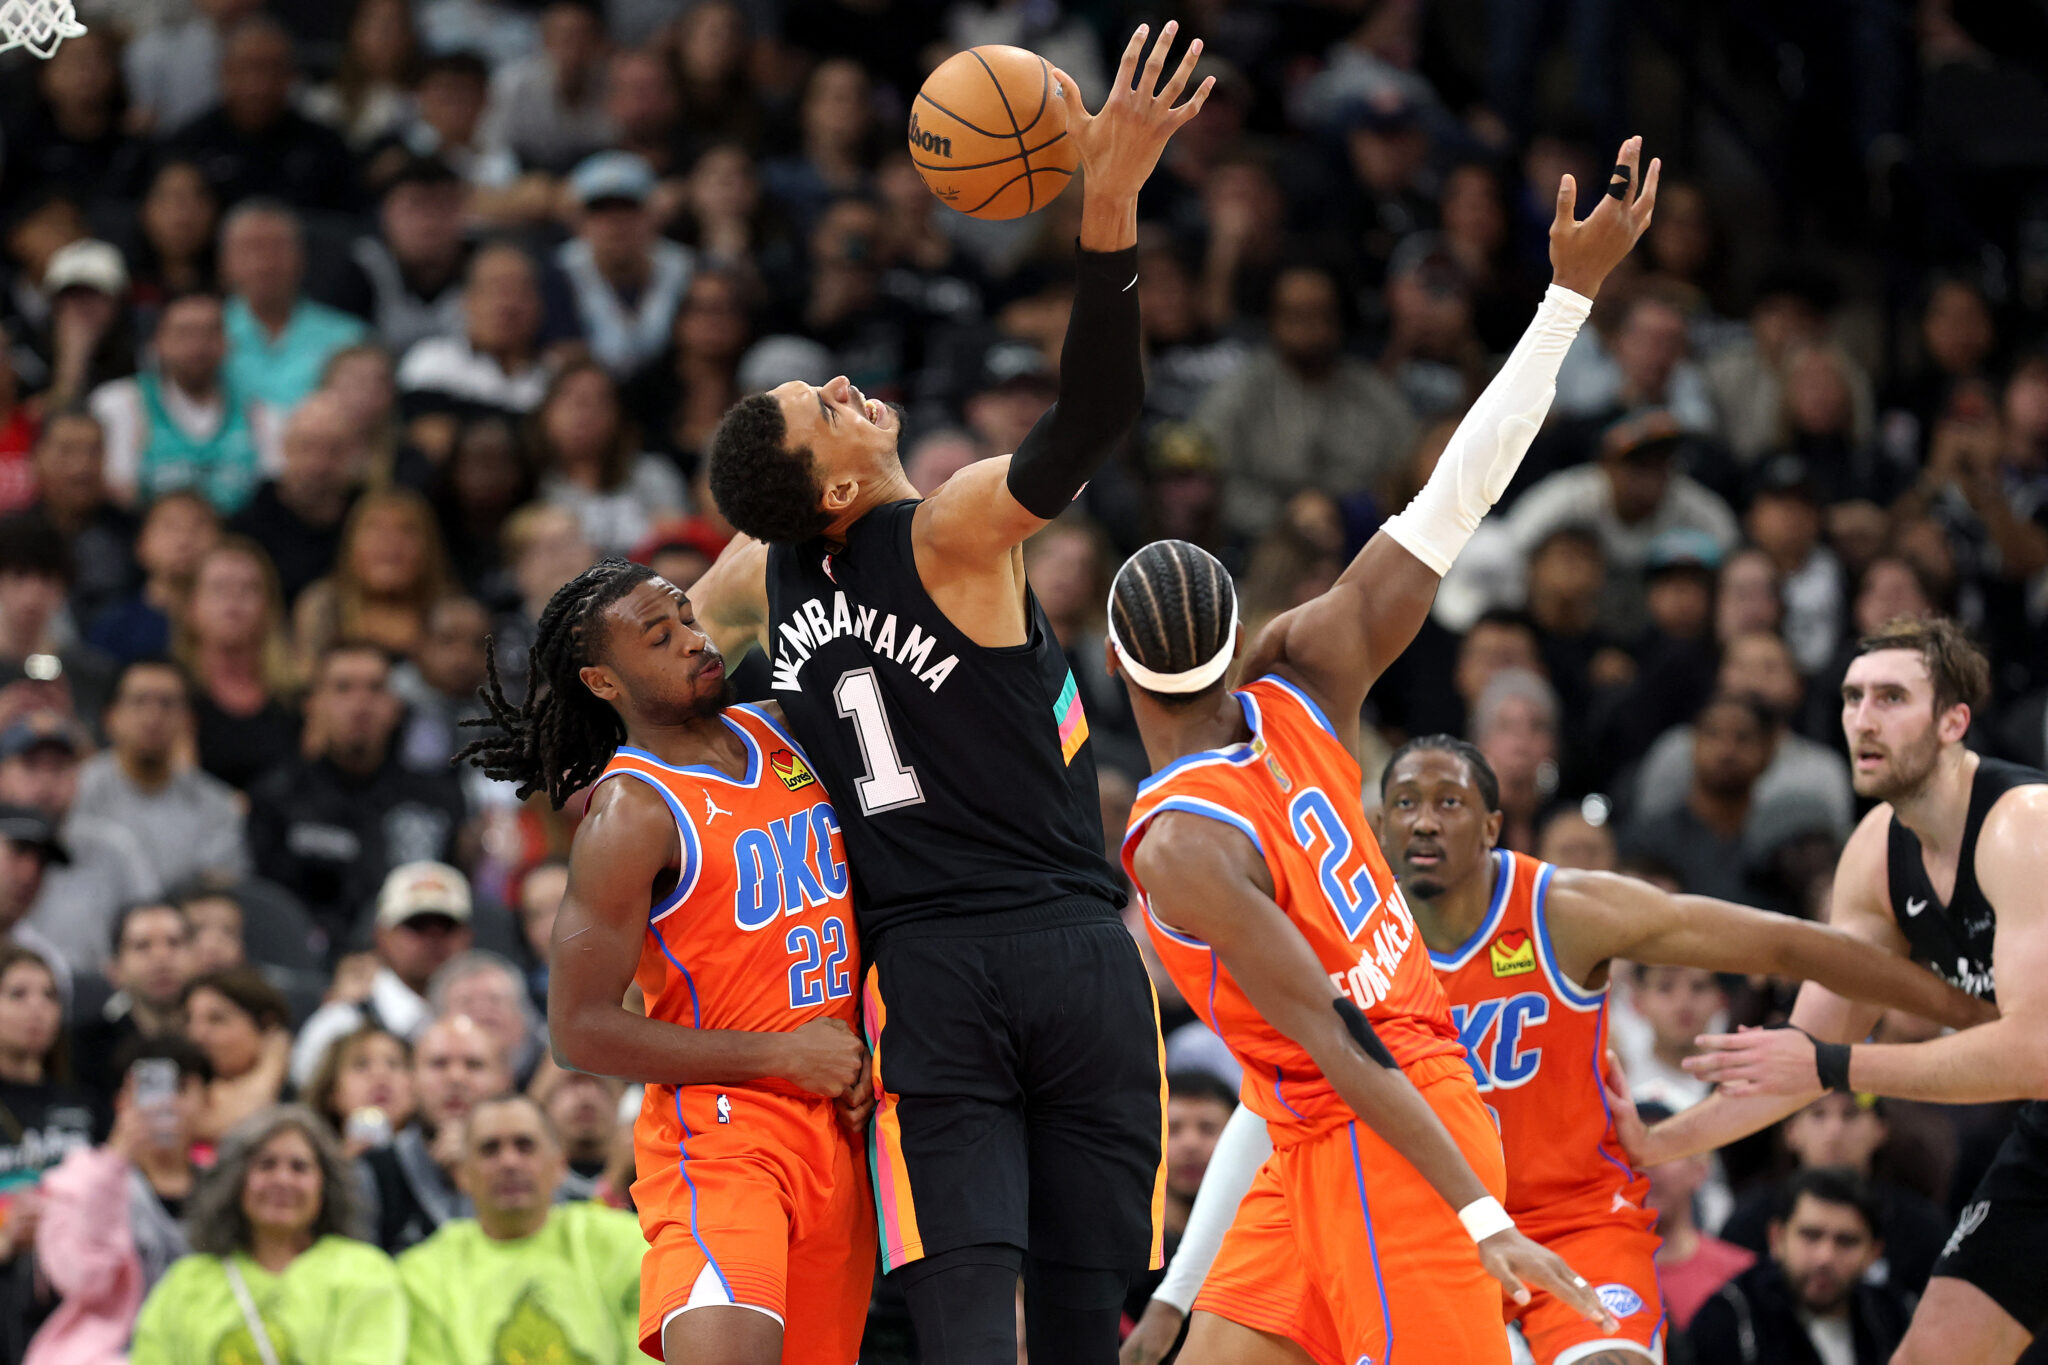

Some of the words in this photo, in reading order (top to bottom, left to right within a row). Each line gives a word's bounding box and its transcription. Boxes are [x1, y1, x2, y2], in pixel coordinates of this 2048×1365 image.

[908, 112, 952, 159] lson
[832, 666, 926, 817] 1
[733, 802, 849, 931] OKC
[1288, 786, 1381, 942] 2
[785, 916, 852, 1009] 22
[1450, 991, 1549, 1092] KC
